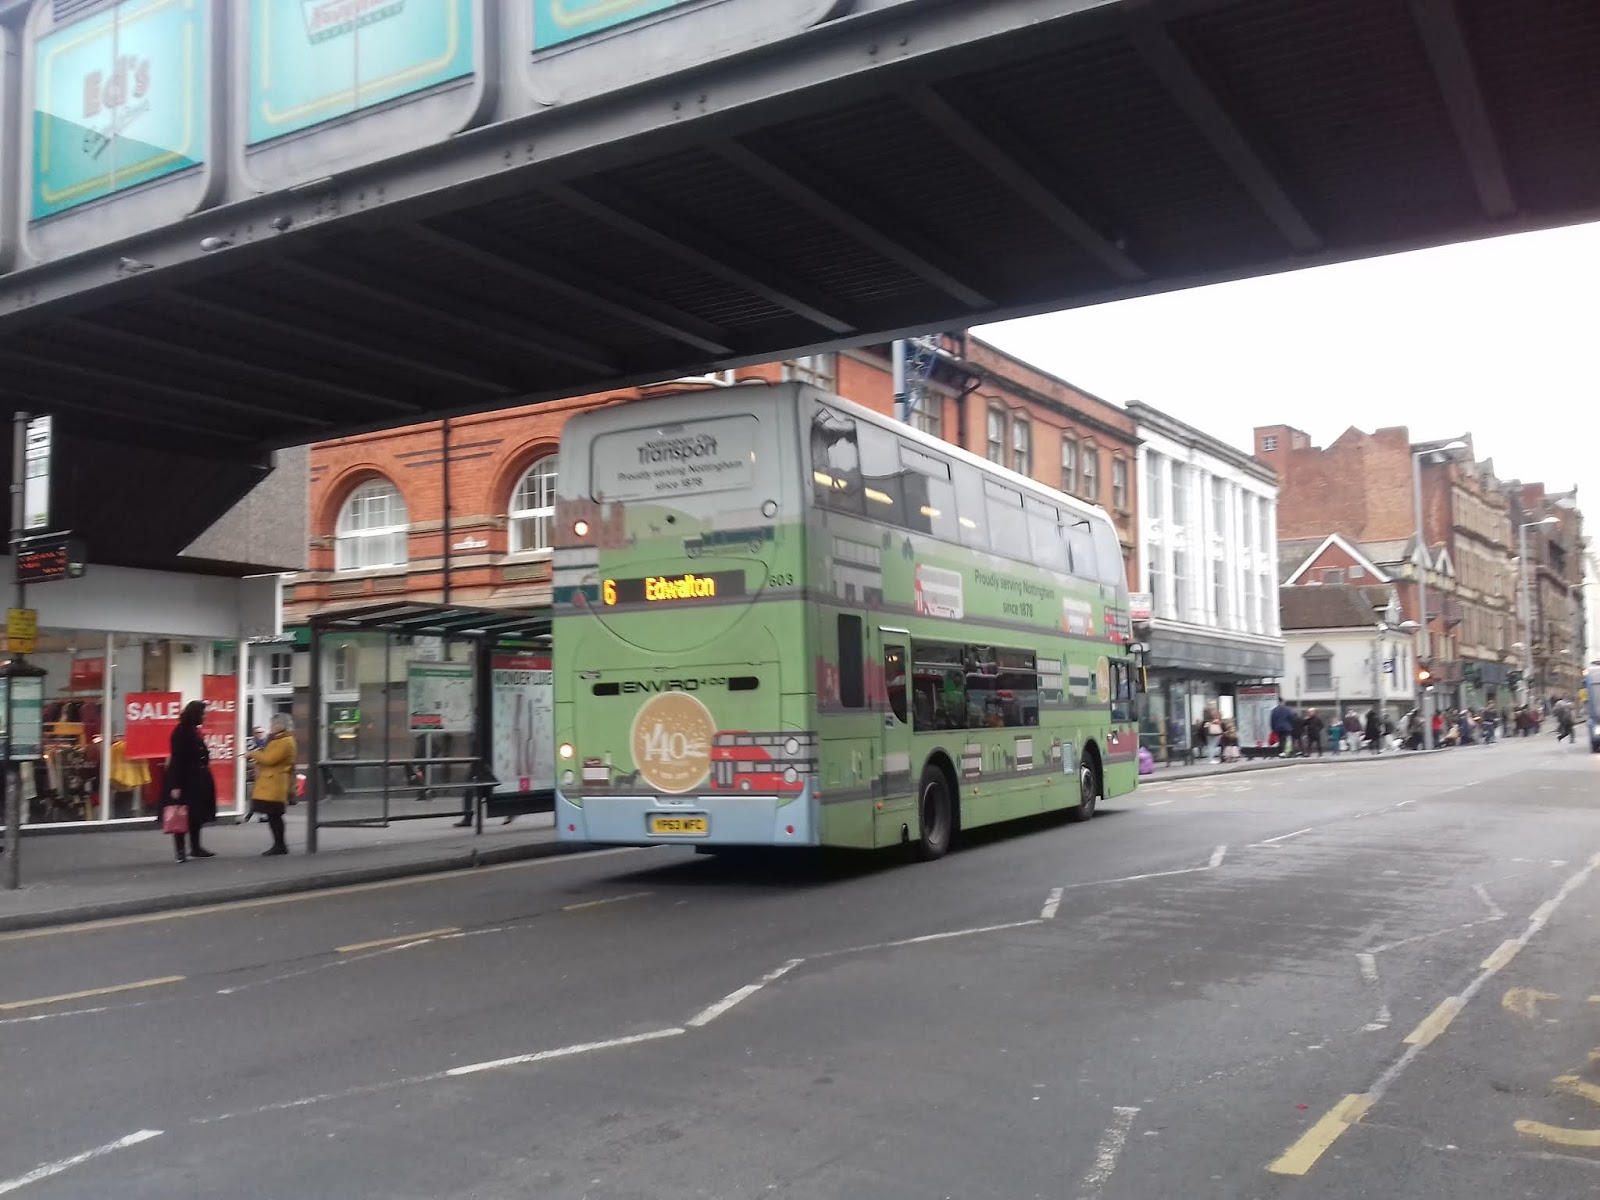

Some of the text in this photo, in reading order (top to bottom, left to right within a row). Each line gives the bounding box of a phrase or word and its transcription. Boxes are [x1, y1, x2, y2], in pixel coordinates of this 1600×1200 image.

[83, 54, 150, 119] Ed's
[637, 443, 717, 463] Transport
[602, 574, 715, 605] 6 Edwalton
[769, 573, 794, 587] 603
[974, 569, 1000, 592] Proudly
[1001, 578, 1022, 596] serving
[1002, 602, 1019, 615] since
[126, 701, 180, 721] SALE
